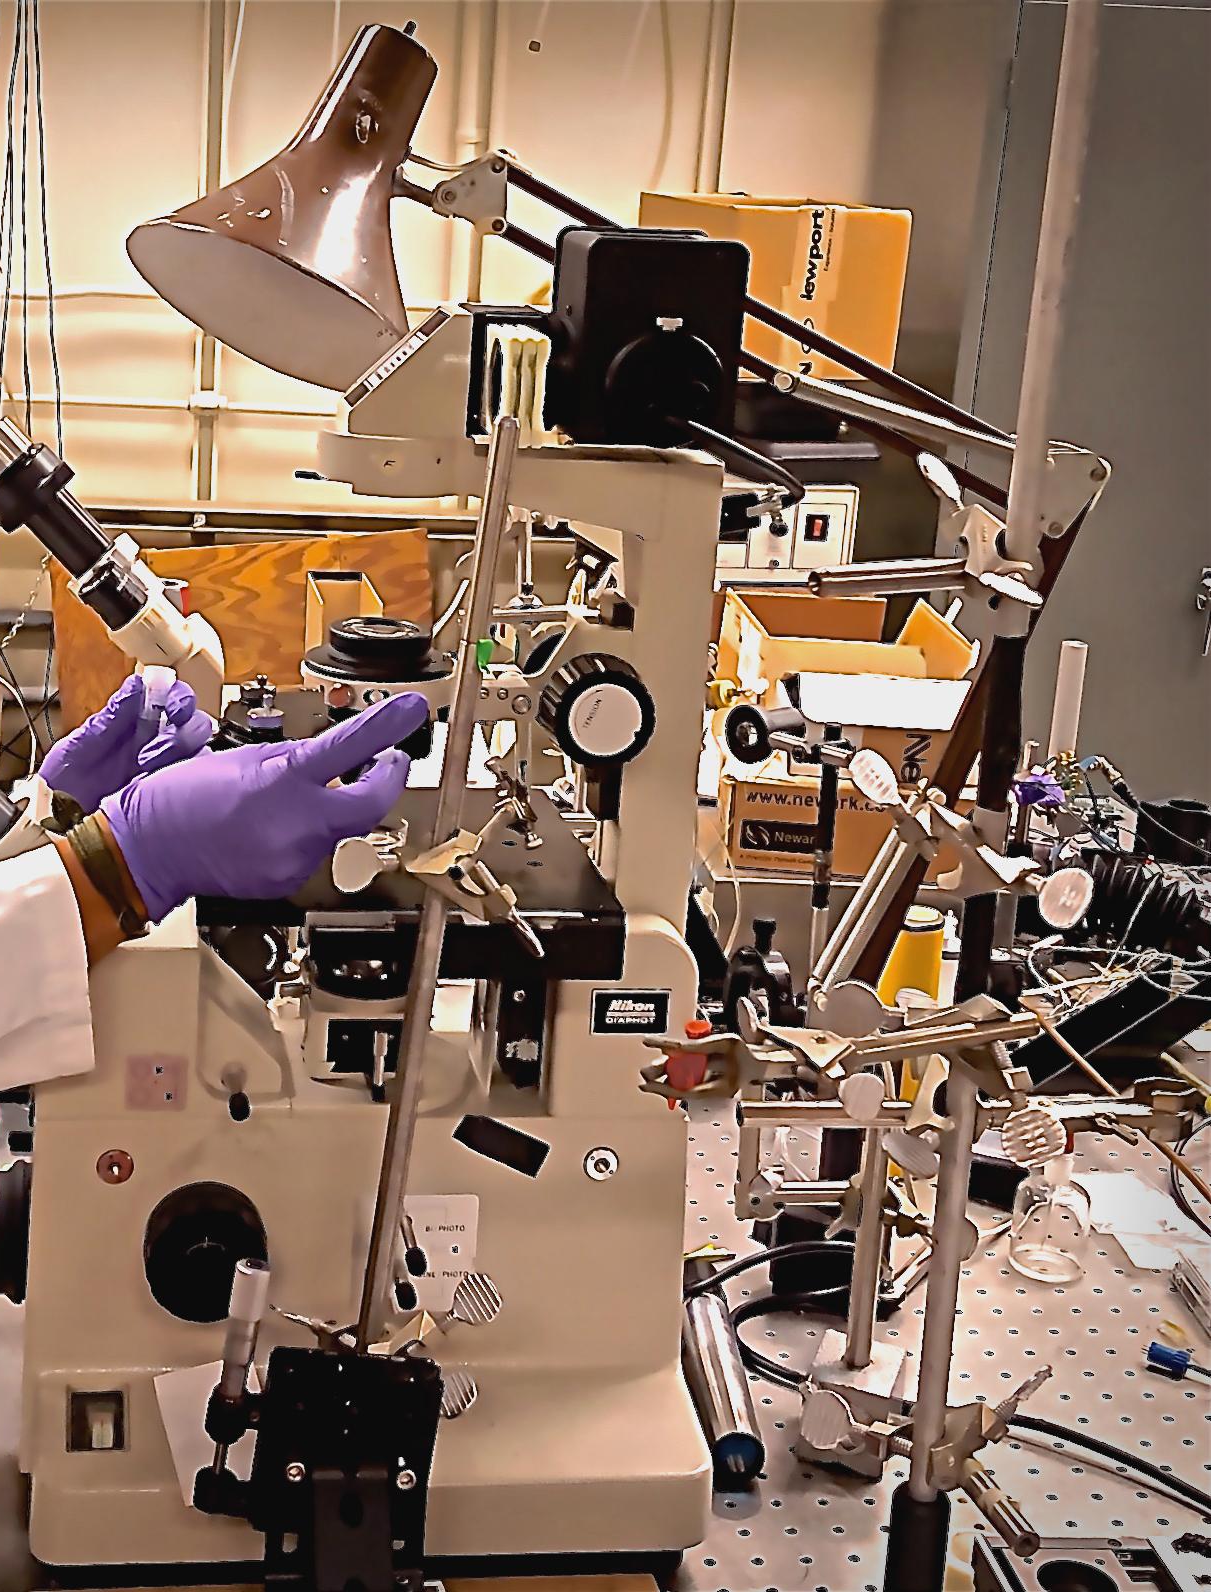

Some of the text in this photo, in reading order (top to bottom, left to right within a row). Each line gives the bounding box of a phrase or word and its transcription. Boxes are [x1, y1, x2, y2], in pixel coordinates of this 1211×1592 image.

[800, 209, 825, 301] ewport
[774, 831, 816, 845] Newar
[608, 999, 655, 1011] Nikon
[439, 1224, 465, 1232] PHOTO
